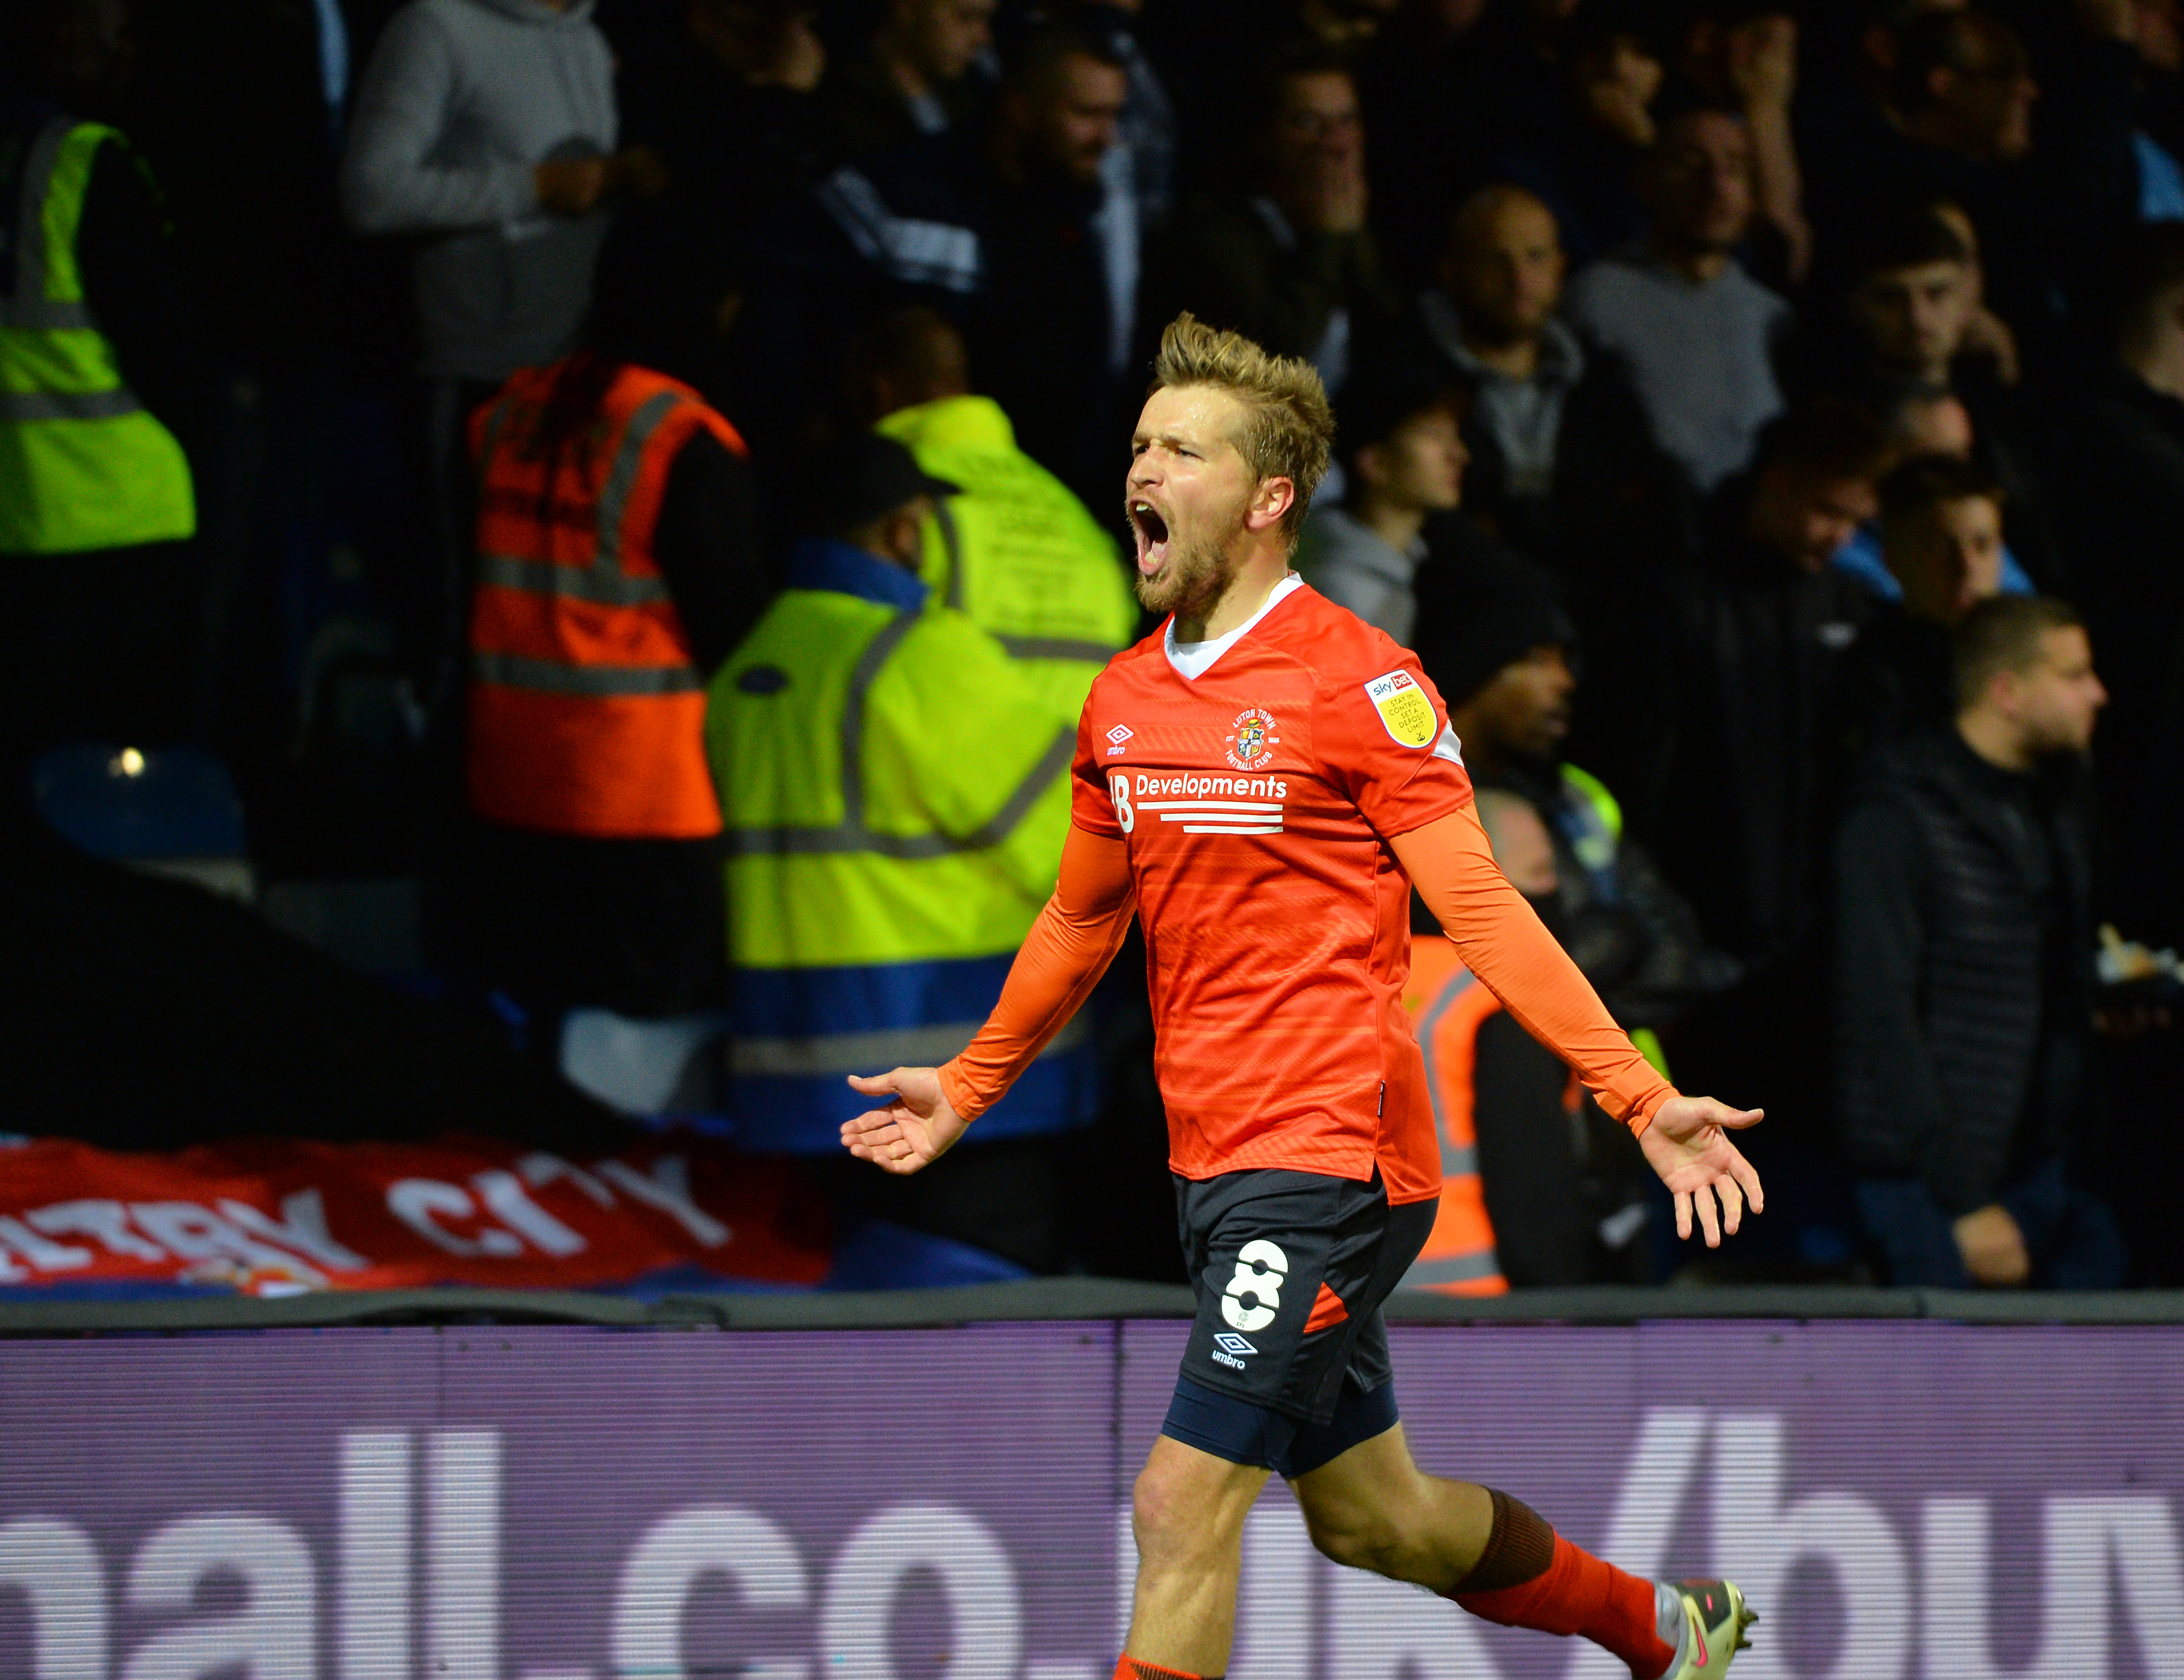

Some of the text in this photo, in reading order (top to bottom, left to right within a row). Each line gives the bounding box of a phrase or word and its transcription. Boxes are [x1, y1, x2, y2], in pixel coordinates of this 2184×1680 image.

[1374, 675, 1410, 696] sky bet
[1389, 699, 1422, 715] CONTROL
[1391, 696, 1405, 707] STAY
[1232, 709, 1277, 730] LUTON TOWN
[1399, 712, 1426, 728] DEPOSIT
[1401, 709, 1412, 719] SET
[1407, 721, 1424, 733] LIMIT
[1226, 749, 1273, 771] FOOTBALL CLUB
[1136, 773, 1287, 799] Developments
[1222, 1239, 1288, 1331] 8
[1212, 1349, 1246, 1370] umbro
